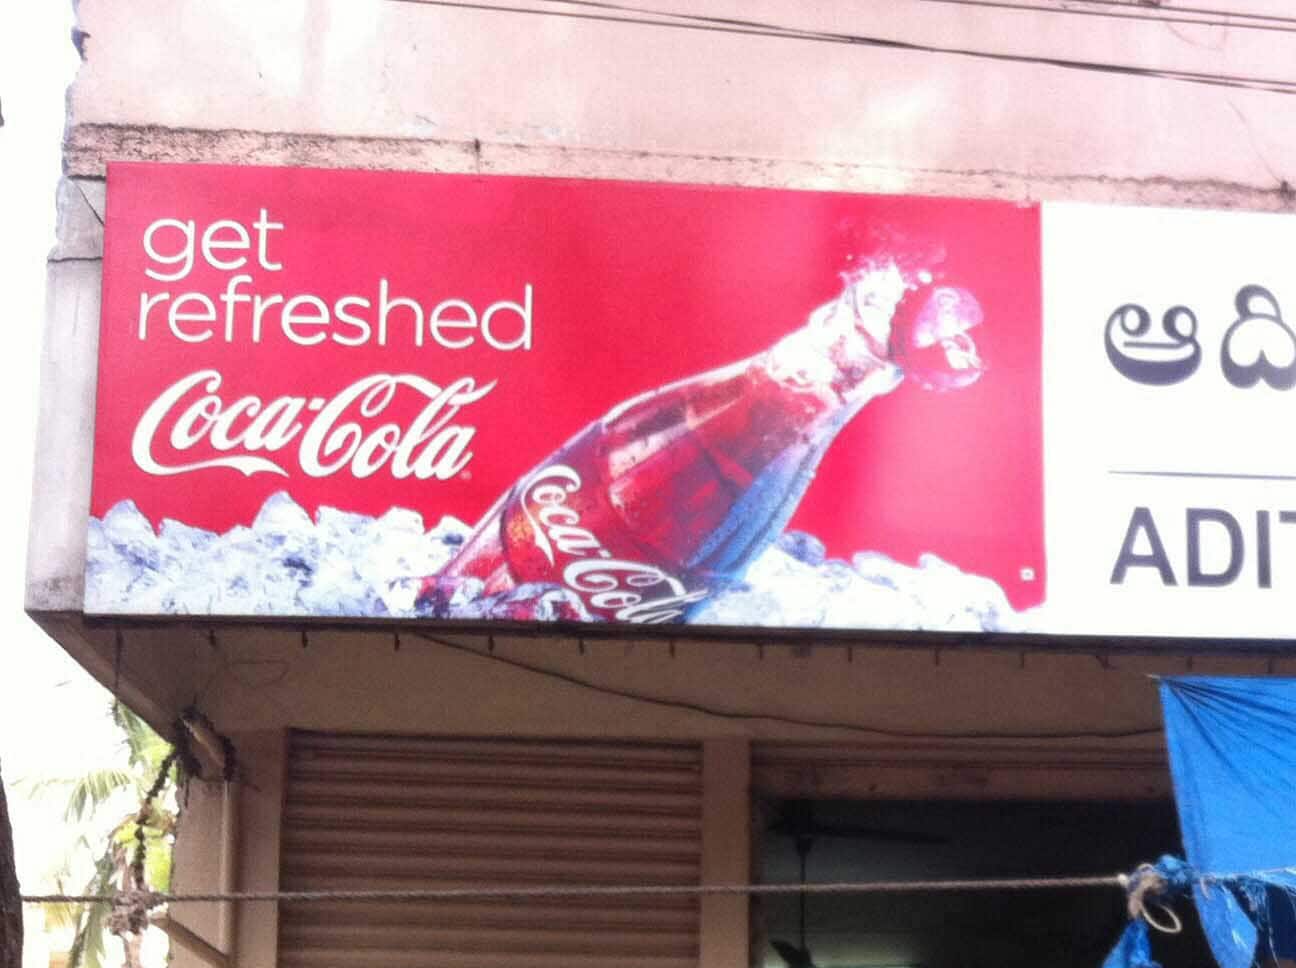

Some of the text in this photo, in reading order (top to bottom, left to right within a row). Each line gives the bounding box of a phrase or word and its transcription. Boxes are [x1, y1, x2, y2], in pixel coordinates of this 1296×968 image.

[142, 208, 284, 281] get
[138, 275, 533, 350] refreshed
[131, 370, 498, 480] Coca-Cola
[521, 465, 708, 623] Coca-Col
